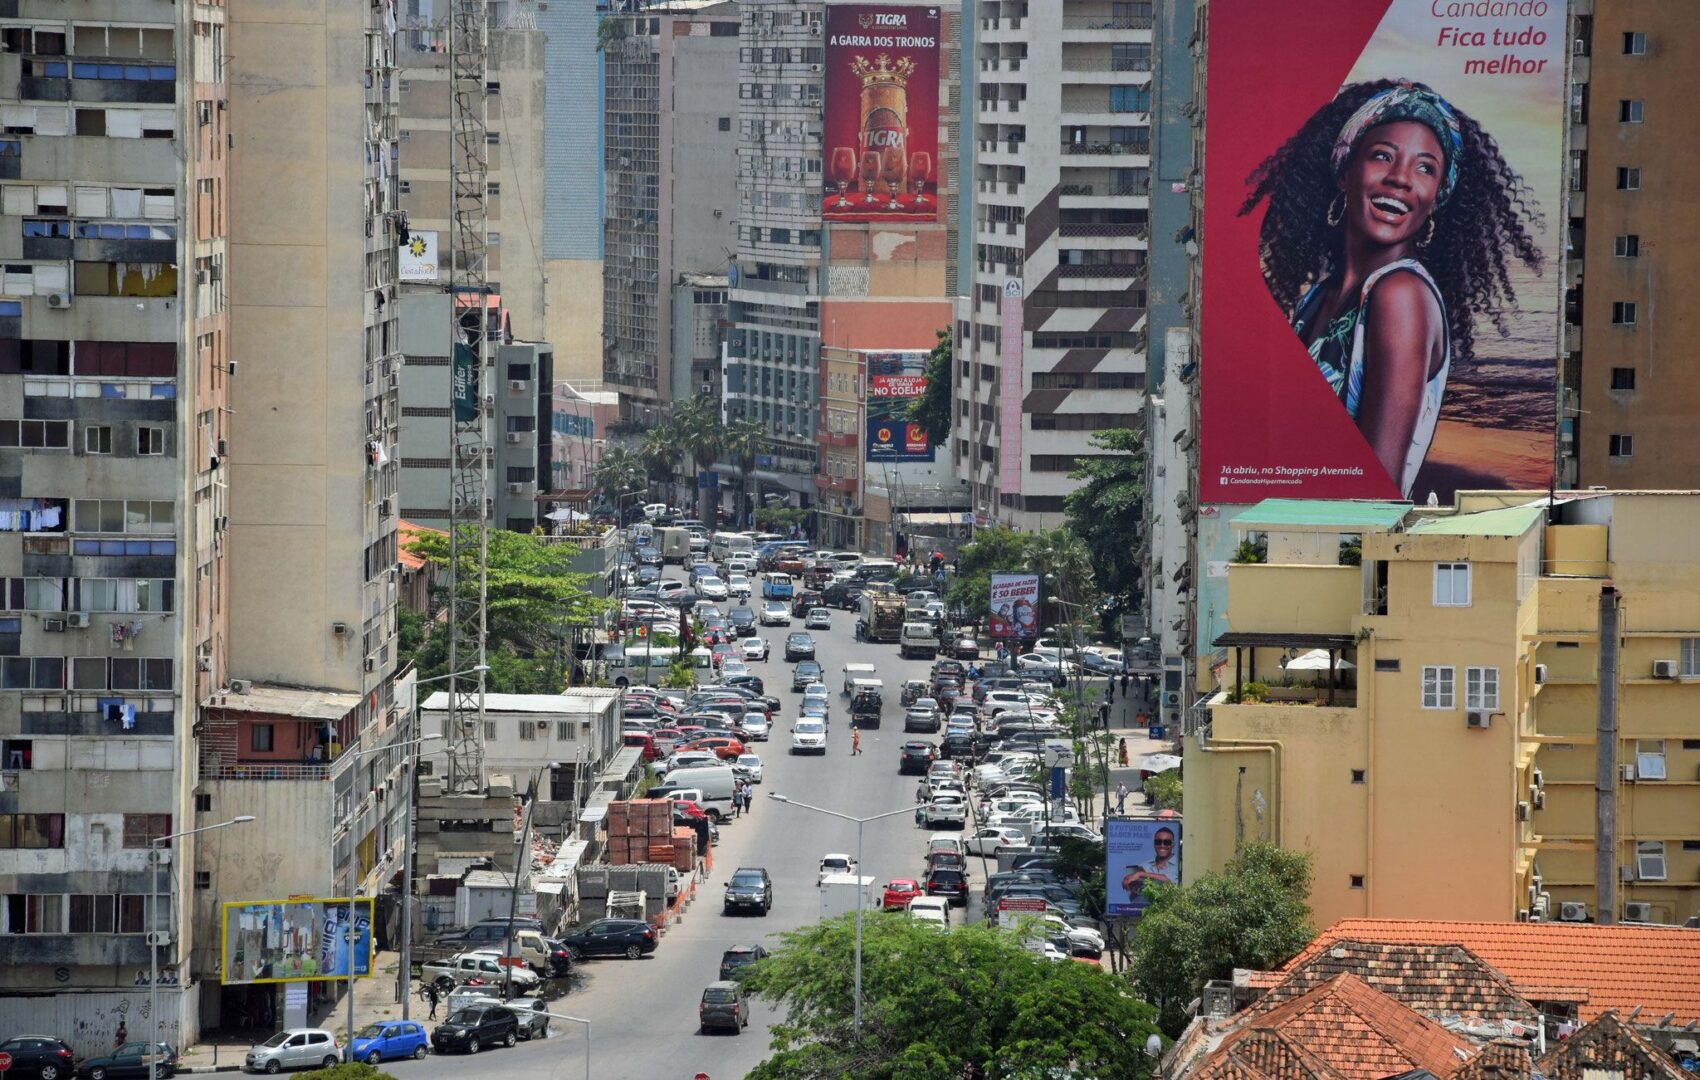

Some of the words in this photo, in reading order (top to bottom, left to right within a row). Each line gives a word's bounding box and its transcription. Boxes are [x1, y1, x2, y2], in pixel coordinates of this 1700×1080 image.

[1431, 0, 1548, 17] Candando
[875, 14, 907, 26] TIGRA
[830, 36, 837, 46] A
[839, 35, 871, 46] GARRA
[874, 36, 893, 47] DOS
[896, 36, 935, 48] TRONOS
[1438, 27, 1486, 46] Fica
[1493, 26, 1547, 46] tudo
[1464, 54, 1548, 74] melhor
[864, 130, 905, 148] TIGRA
[454, 364, 466, 400] Edifer
[874, 387, 889, 396] NO
[1221, 465, 1232, 474] Já
[1275, 465, 1319, 477] Shopping
[1010, 587, 1036, 596] BEBER
